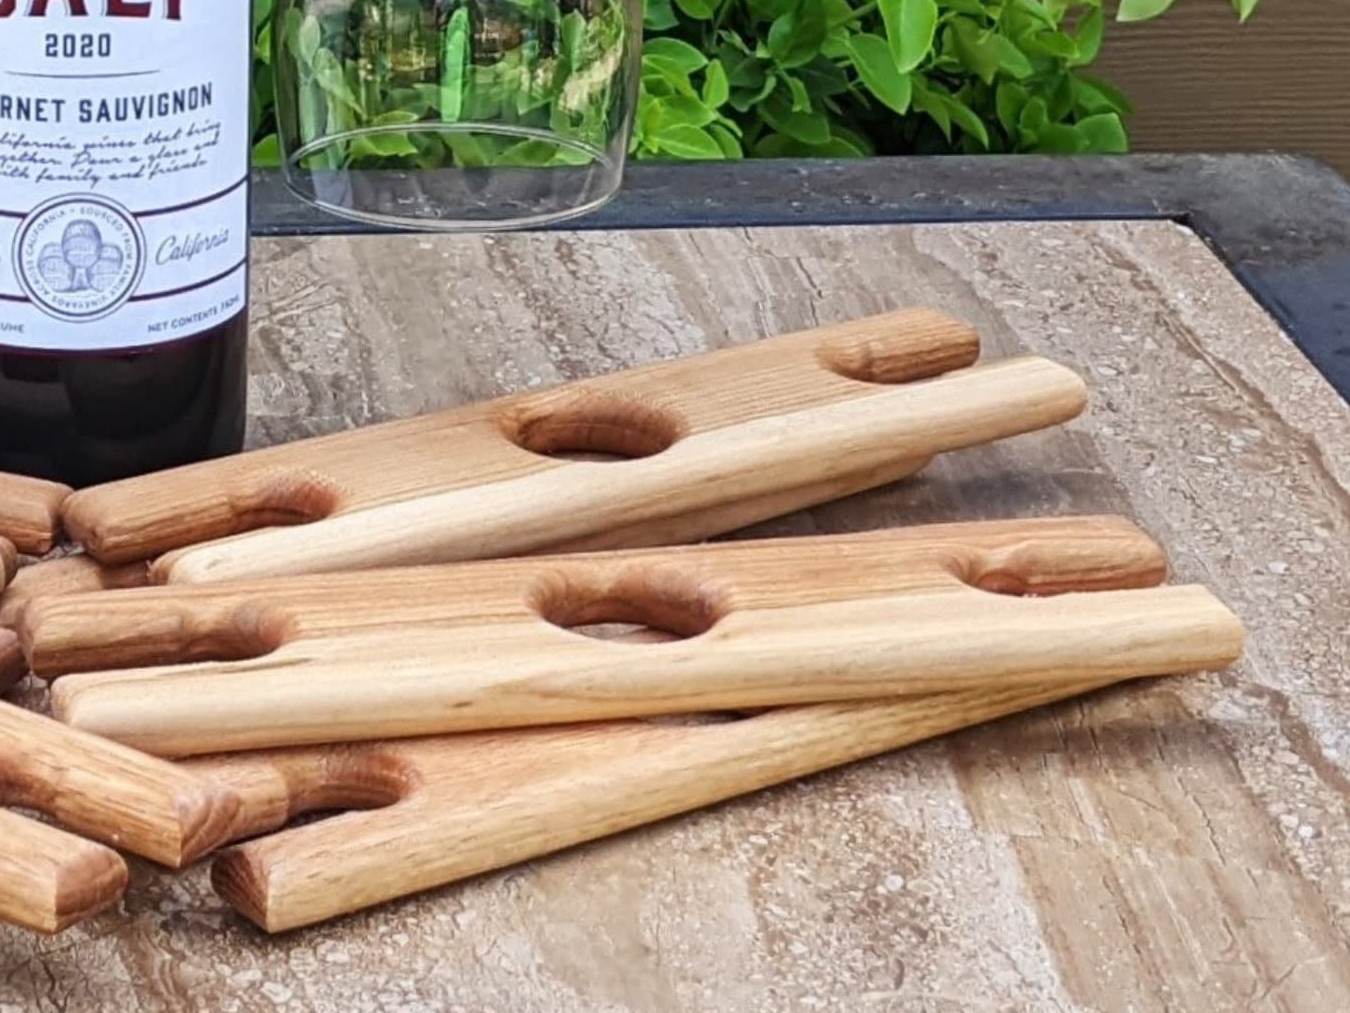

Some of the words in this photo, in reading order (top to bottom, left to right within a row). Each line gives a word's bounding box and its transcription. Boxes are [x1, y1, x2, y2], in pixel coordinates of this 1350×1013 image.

[45, 33, 111, 58] 2020
[77, 81, 213, 124] SAUVIGNON
[143, 128, 182, 146] that
[186, 119, 221, 138] bring
[148, 145, 188, 168] glass
[194, 130, 219, 151] and
[35, 168, 100, 189] family
[108, 164, 145, 180] and
[79, 206, 123, 231] SOURCED
[25, 209, 66, 256] CALIFORNIA
[155, 228, 230, 266] California
[147, 321, 169, 333] NET
[170, 306, 218, 329] CONTENTS
